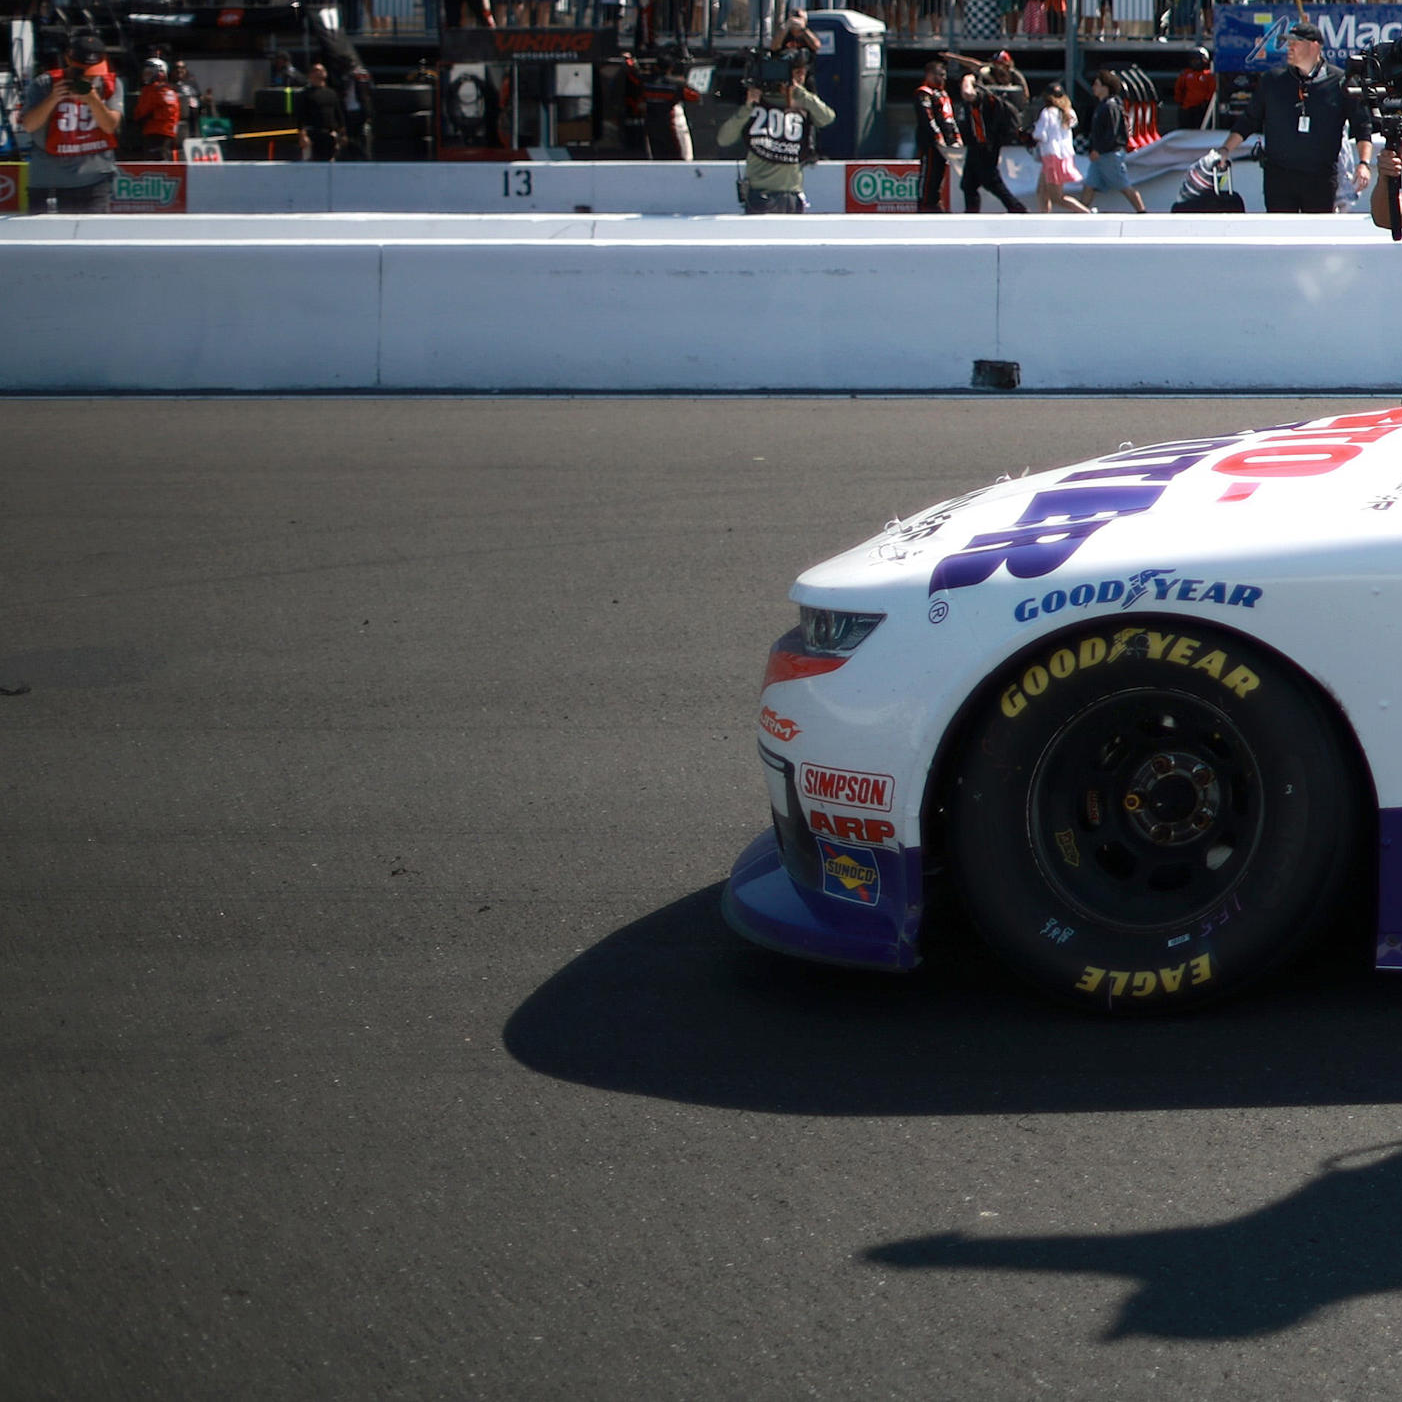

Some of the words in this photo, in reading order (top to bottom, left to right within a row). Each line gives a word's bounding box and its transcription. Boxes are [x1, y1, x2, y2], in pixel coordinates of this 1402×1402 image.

[494, 32, 594, 52] VIKING
[749, 105, 804, 142] 206
[117, 177, 177, 203] Reilly
[503, 169, 533, 197] 13
[856, 172, 919, 198] O'Reil
[803, 768, 886, 806] SIMPSON
[810, 811, 896, 844] ARP
[826, 861, 874, 883] SUNOCO
[1076, 950, 1214, 998] EAGLE
